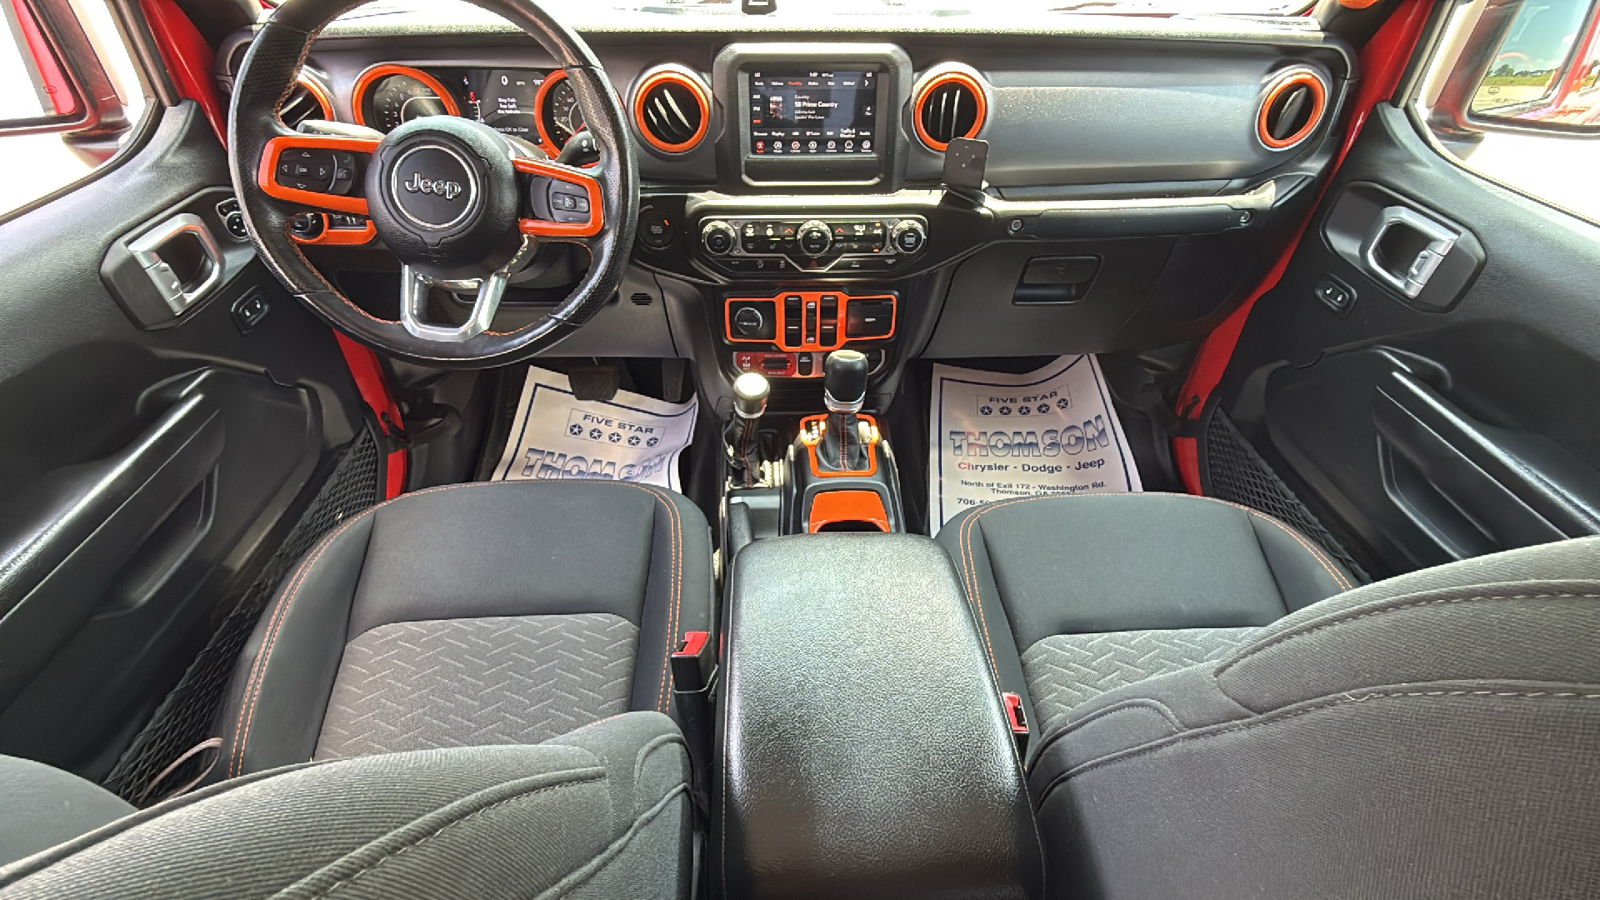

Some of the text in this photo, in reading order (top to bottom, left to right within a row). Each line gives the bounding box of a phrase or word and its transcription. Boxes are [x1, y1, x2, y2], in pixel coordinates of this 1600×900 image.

[501, 75, 509, 86] 0
[404, 172, 462, 200] Jeep
[988, 390, 1058, 404] FIVE STAR
[582, 413, 654, 435] FIVE STAR
[949, 414, 1110, 458] THOMSON
[957, 461, 1010, 473] Chrysler
[1021, 463, 1063, 474] Dodge
[1074, 457, 1105, 471] Jeep
[960, 480, 984, 488] North
[1038, 484, 1089, 493] Washington
[1091, 481, 1107, 489] Rd.
